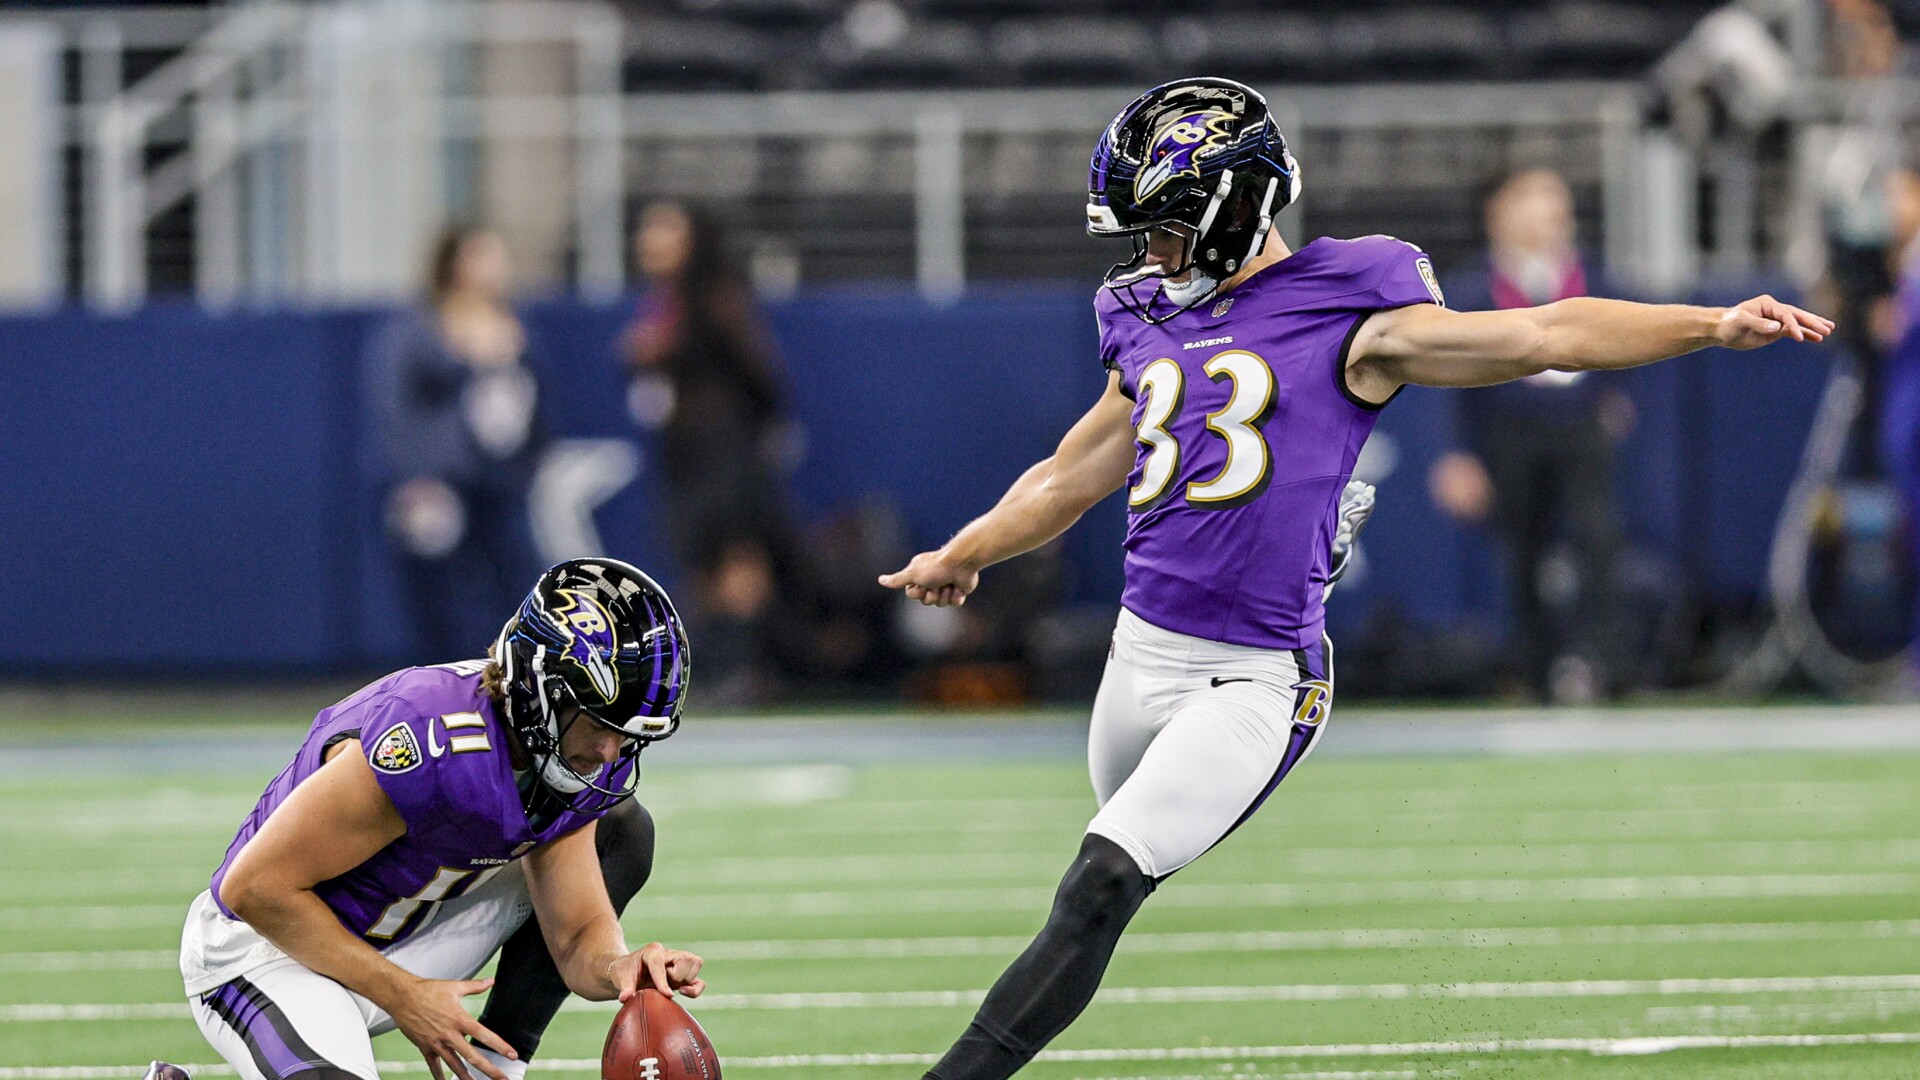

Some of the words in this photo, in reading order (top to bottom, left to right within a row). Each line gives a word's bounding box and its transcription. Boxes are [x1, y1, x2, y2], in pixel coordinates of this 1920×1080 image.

[1183, 336, 1234, 350] RAVENS
[1129, 349, 1277, 513] 33
[400, 727, 418, 761] RAVENS
[440, 711, 493, 753] 11
[469, 858, 509, 866] RAVENS
[685, 1028, 702, 1057] LEAGUE
